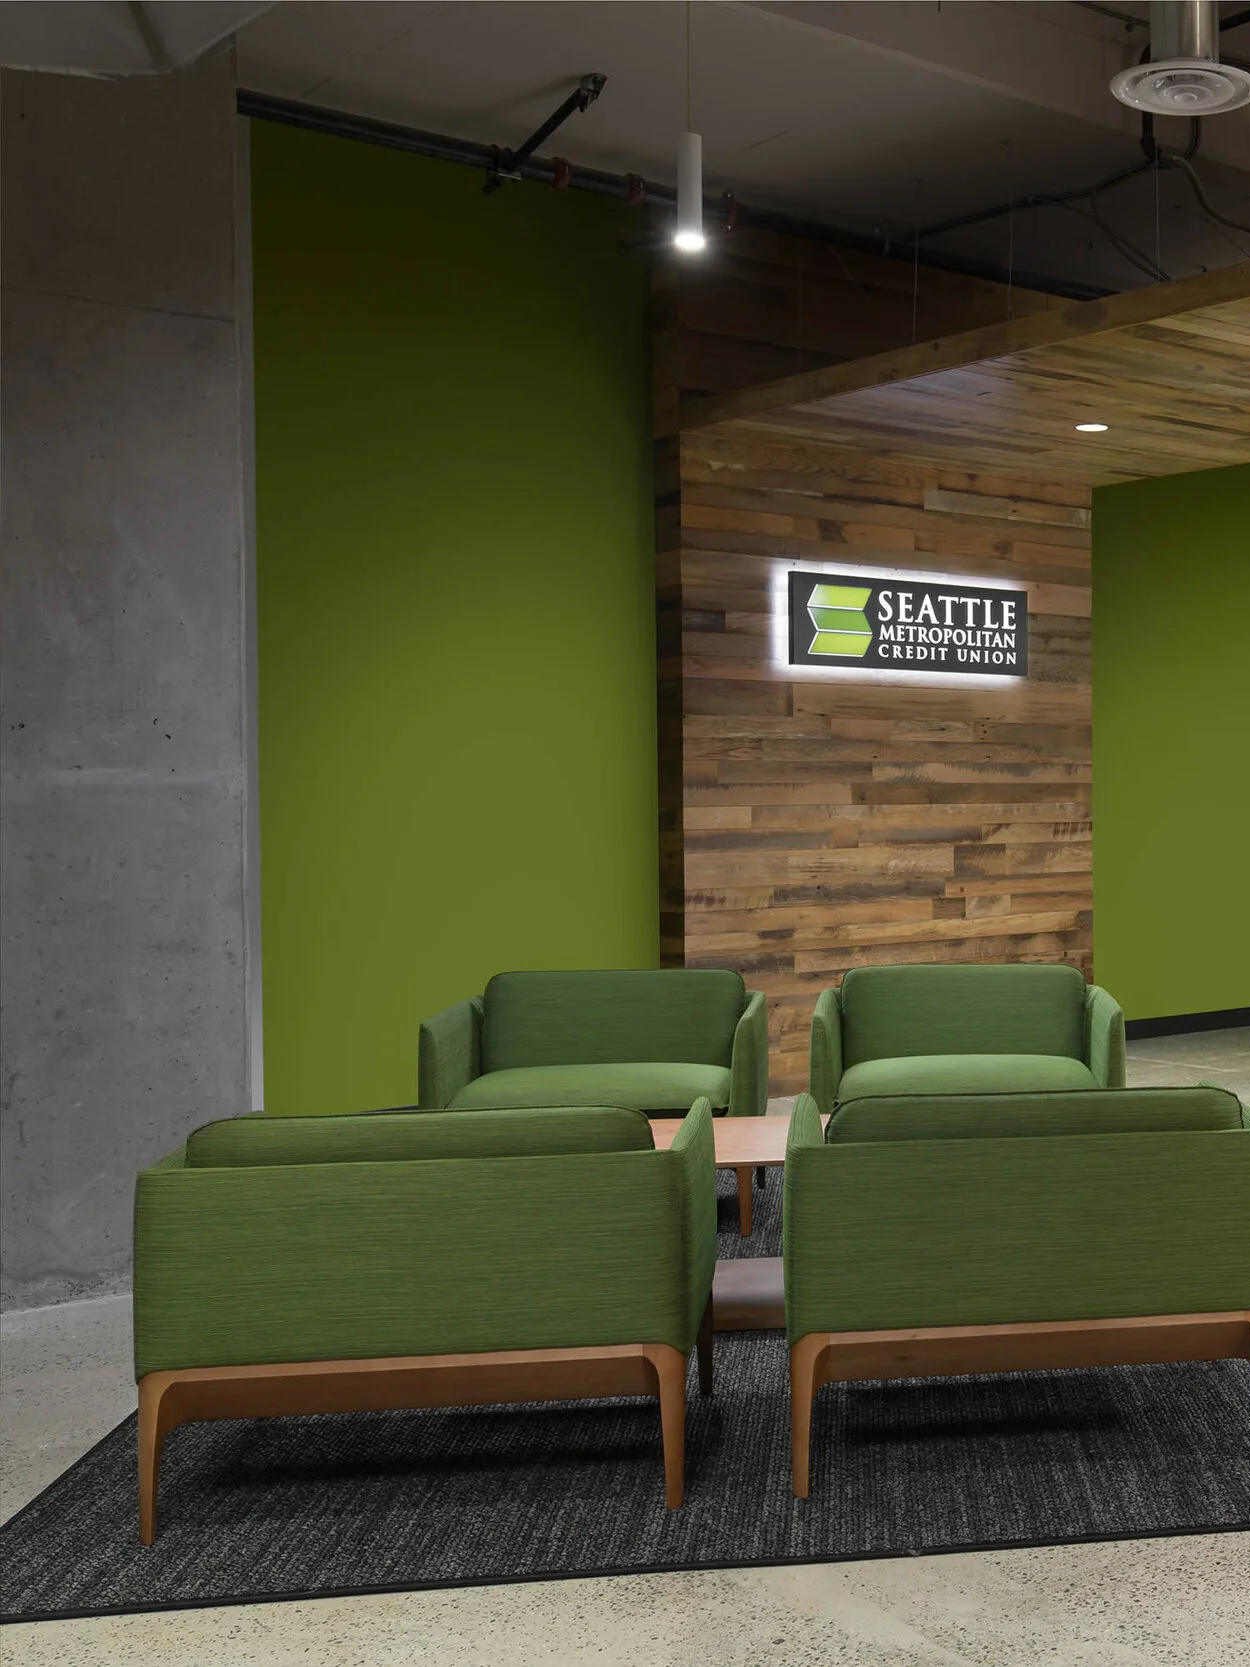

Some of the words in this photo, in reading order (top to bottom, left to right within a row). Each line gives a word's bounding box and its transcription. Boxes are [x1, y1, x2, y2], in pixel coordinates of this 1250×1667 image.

[878, 590, 1016, 630] SEATTLE
[879, 625, 1016, 649] METROPOLITAN
[878, 644, 948, 661] CREDIT
[957, 649, 1016, 665] UNION
